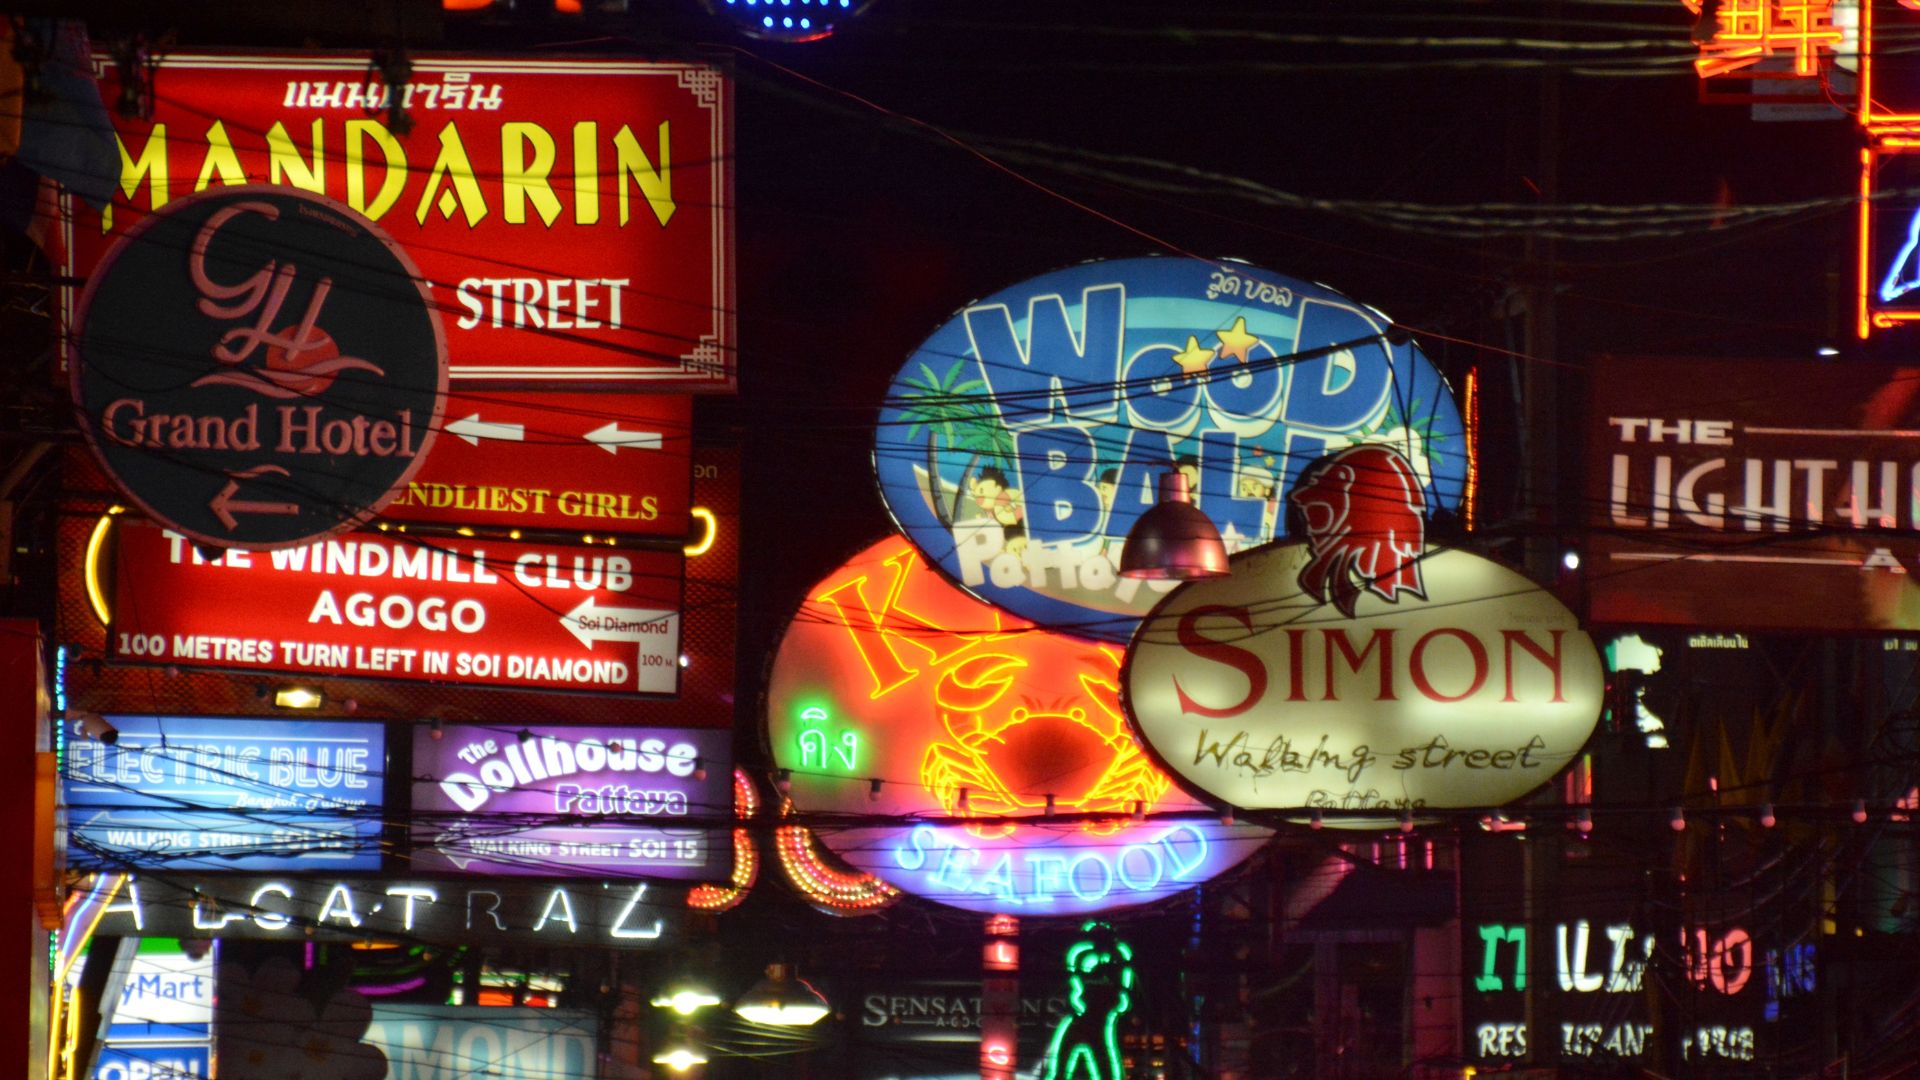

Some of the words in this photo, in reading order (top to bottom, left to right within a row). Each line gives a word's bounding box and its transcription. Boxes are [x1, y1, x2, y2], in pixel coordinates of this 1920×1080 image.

[103, 117, 677, 235] MANDARIN
[456, 277, 630, 330] STREET
[964, 283, 1393, 430] WOOD
[102, 399, 261, 449] Grand
[275, 406, 415, 457] Hotel
[1609, 417, 1733, 446] THE
[558, 490, 658, 520] GIRLS
[270, 541, 497, 585] WINDMILL
[514, 552, 632, 592] CLUB
[308, 589, 485, 634] AGOGO
[578, 615, 600, 630] Soi
[604, 616, 669, 635] Diamond
[119, 633, 165, 656] 100
[173, 633, 273, 664] METRES
[280, 641, 349, 668] TURN
[355, 646, 416, 672] LEFT
[423, 651, 449, 675] IN
[456, 653, 500, 677] SOI
[507, 656, 629, 684] DIAMOND
[641, 654, 662, 667] 100
[1173, 604, 1568, 718] SIMON
[67, 740, 260, 785] ELECTRIC
[269, 747, 369, 789] BLUE
[440, 736, 698, 812] Dollhouse
[458, 738, 498, 766] The
[1193, 730, 1376, 783] Walking
[1393, 733, 1546, 771] street
[555, 783, 688, 815] Pattaya
[107, 830, 191, 849] WALKING
[199, 832, 261, 849] STREET
[469, 839, 551, 857] WALKING
[559, 842, 619, 858] STREET
[628, 839, 667, 859] SOI
[674, 841, 697, 859] 15
[895, 822, 1209, 906] SEAFOOD
